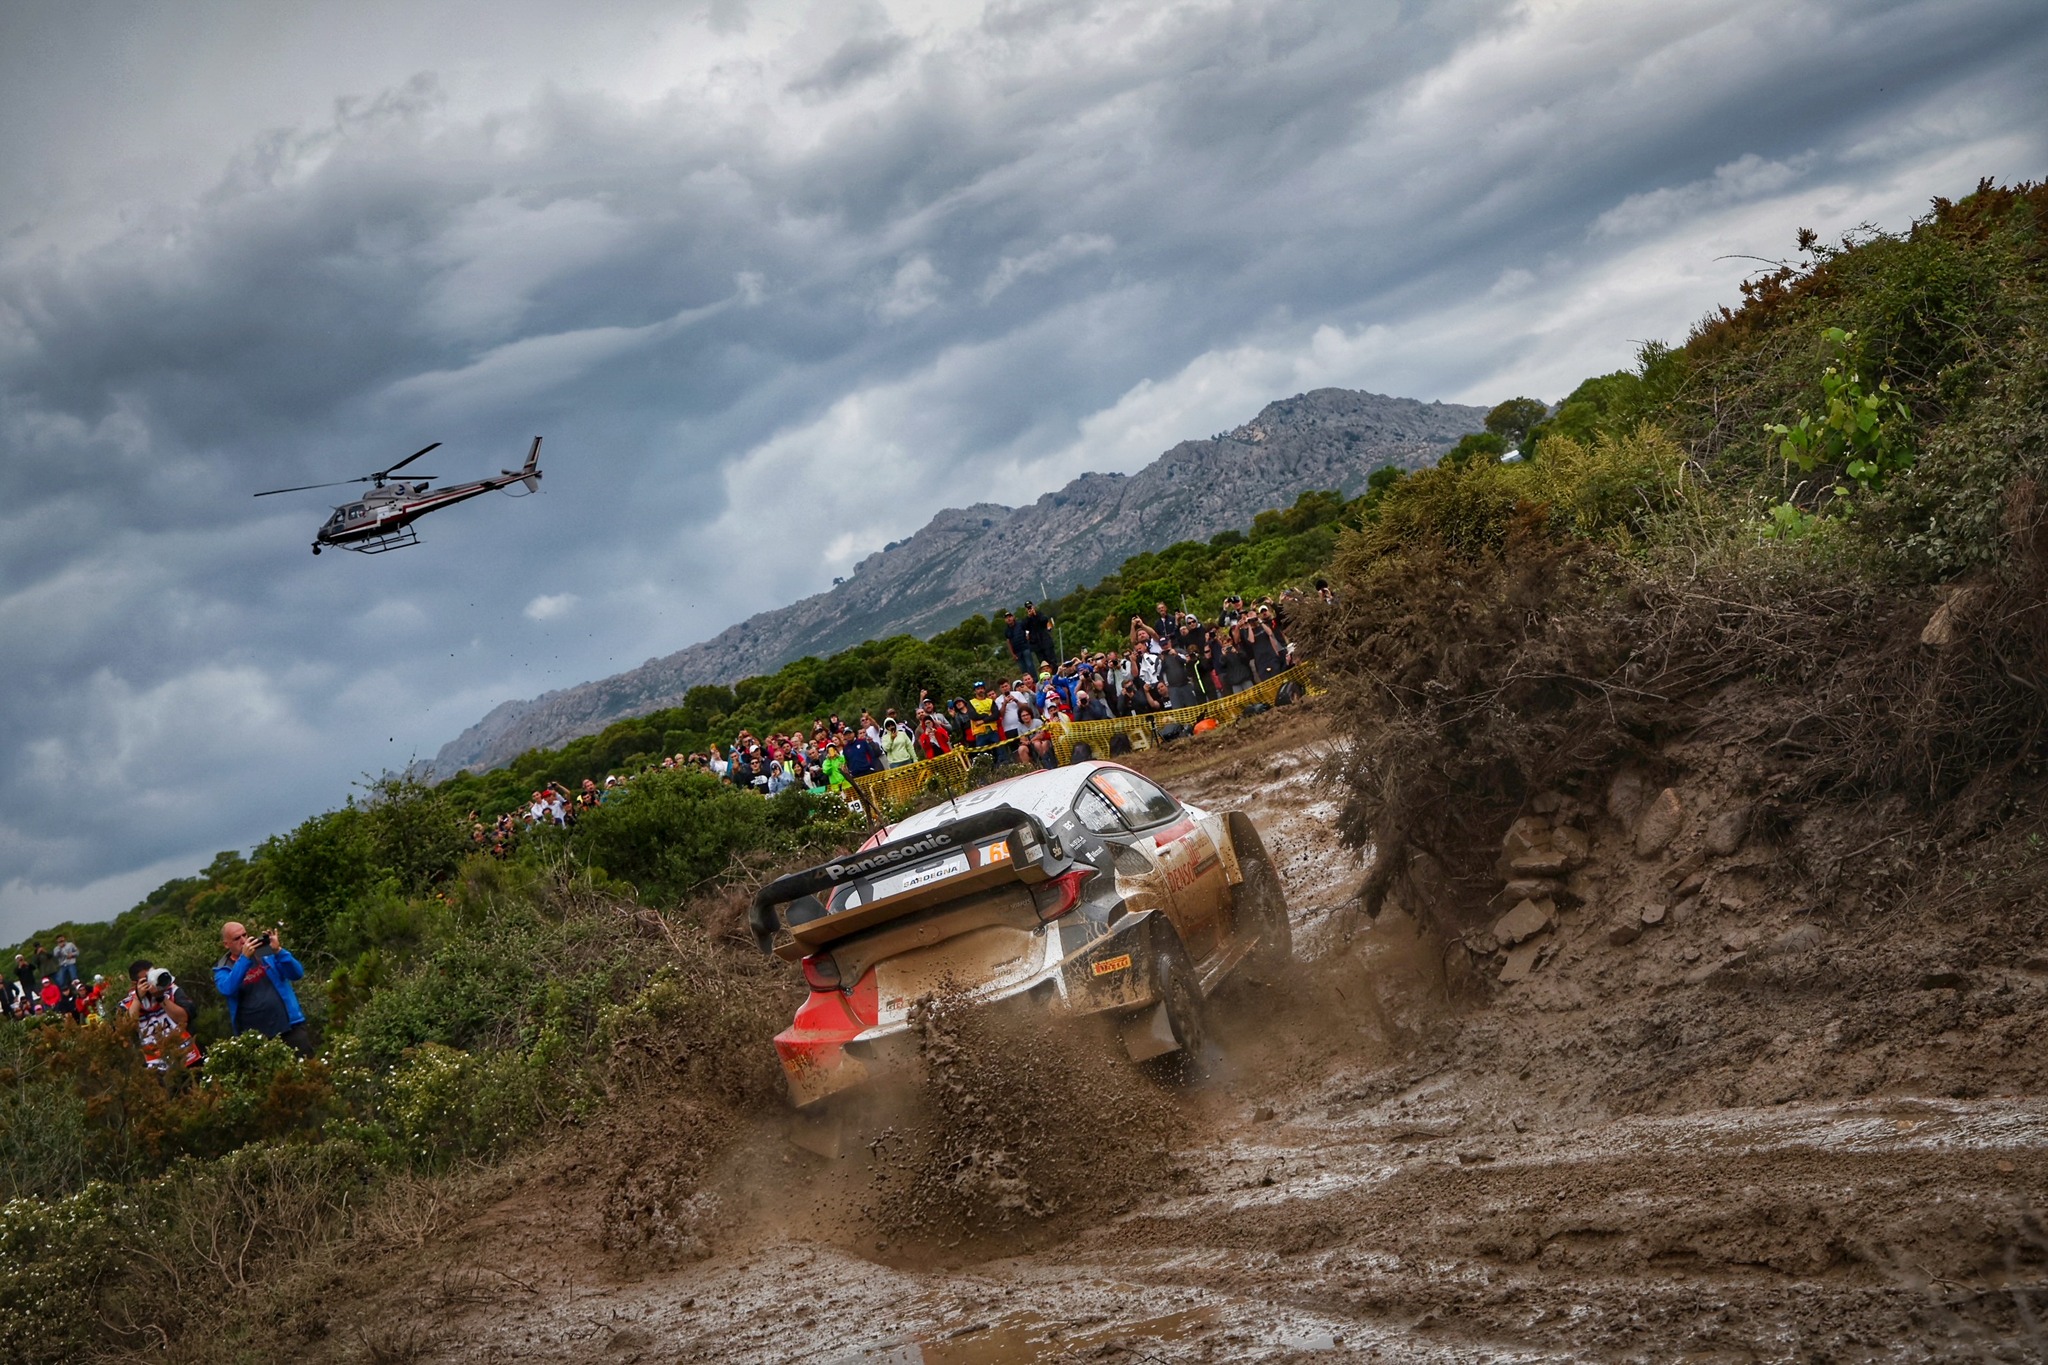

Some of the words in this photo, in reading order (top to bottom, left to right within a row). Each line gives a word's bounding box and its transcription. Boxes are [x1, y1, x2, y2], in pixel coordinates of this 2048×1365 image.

[850, 802, 862, 812] 19
[825, 833, 951, 881] Panasonic
[903, 865, 958, 888] SARDEGNA
[1167, 862, 1194, 893] DENSO
